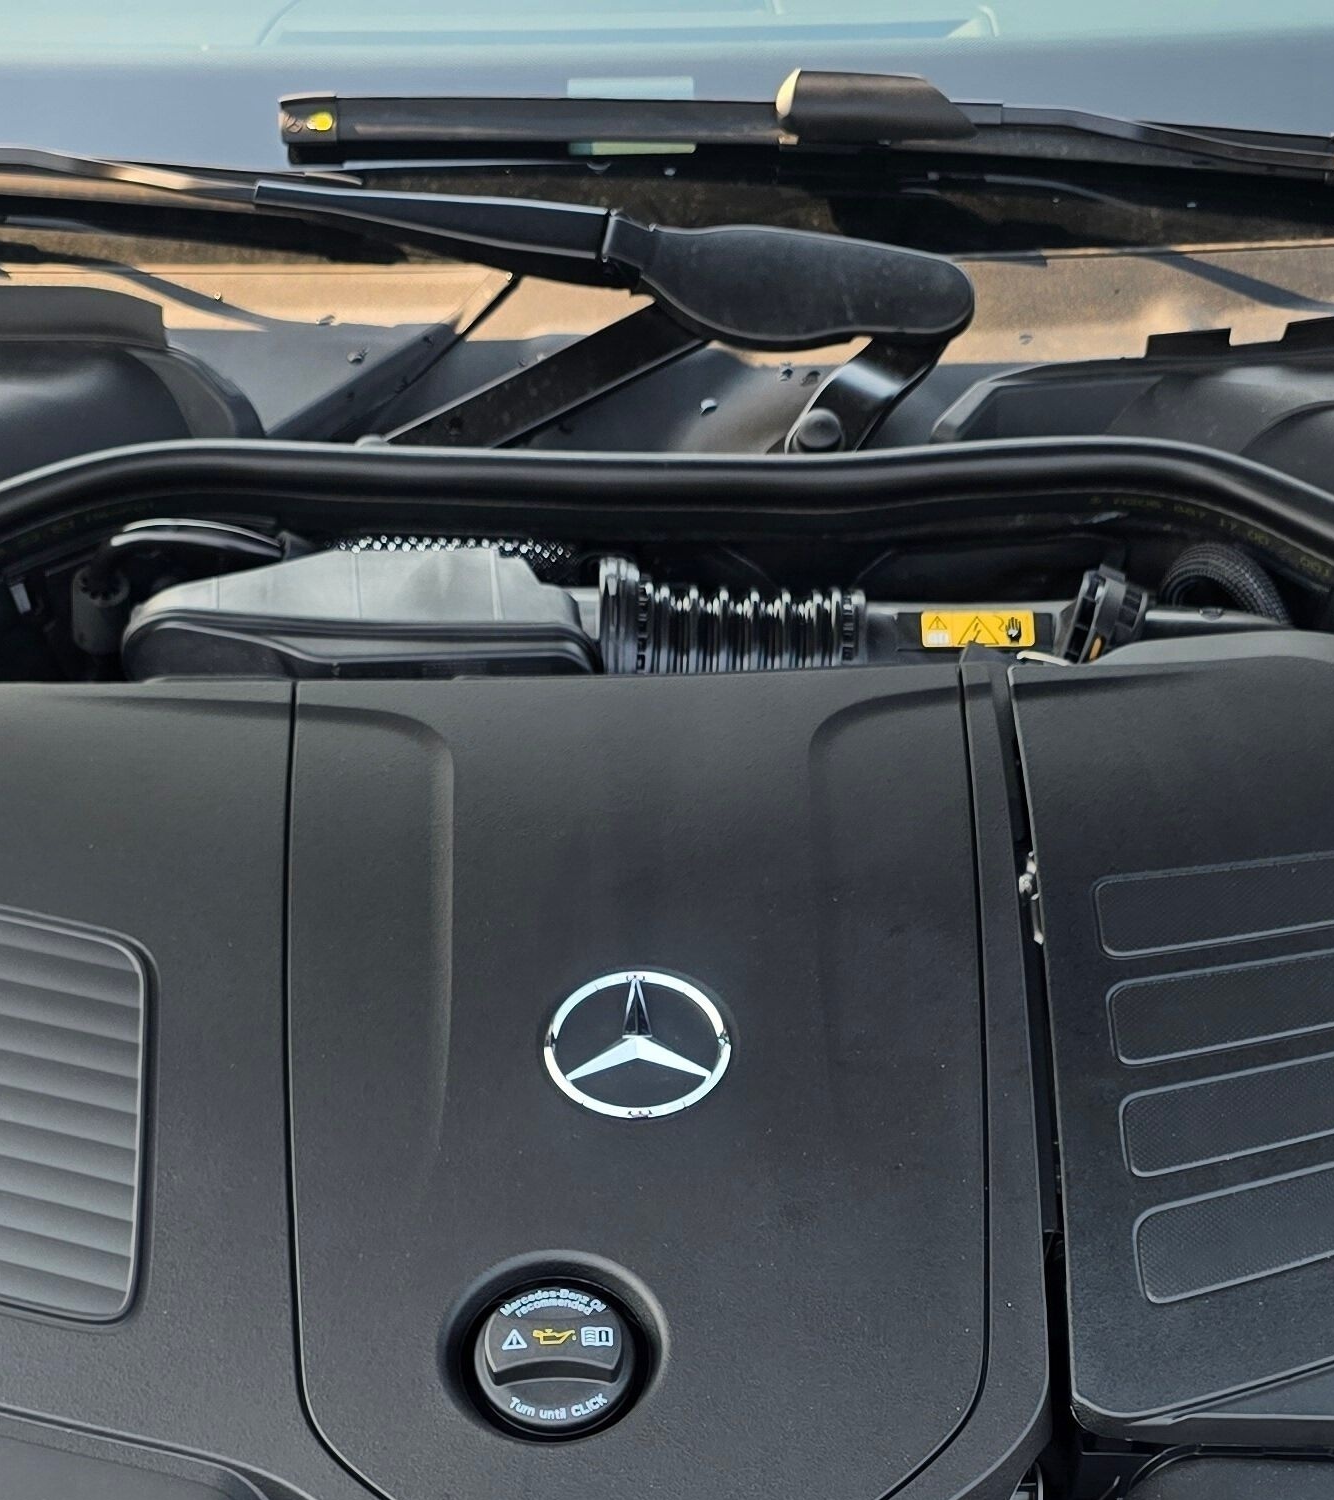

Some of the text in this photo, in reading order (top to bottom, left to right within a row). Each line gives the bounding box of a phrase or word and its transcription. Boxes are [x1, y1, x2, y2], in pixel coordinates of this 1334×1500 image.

[500, 1289, 590, 1316] Mercedes-Benz
[515, 1299, 594, 1317] recommended
[509, 1393, 608, 1420] Turn until CLICK
